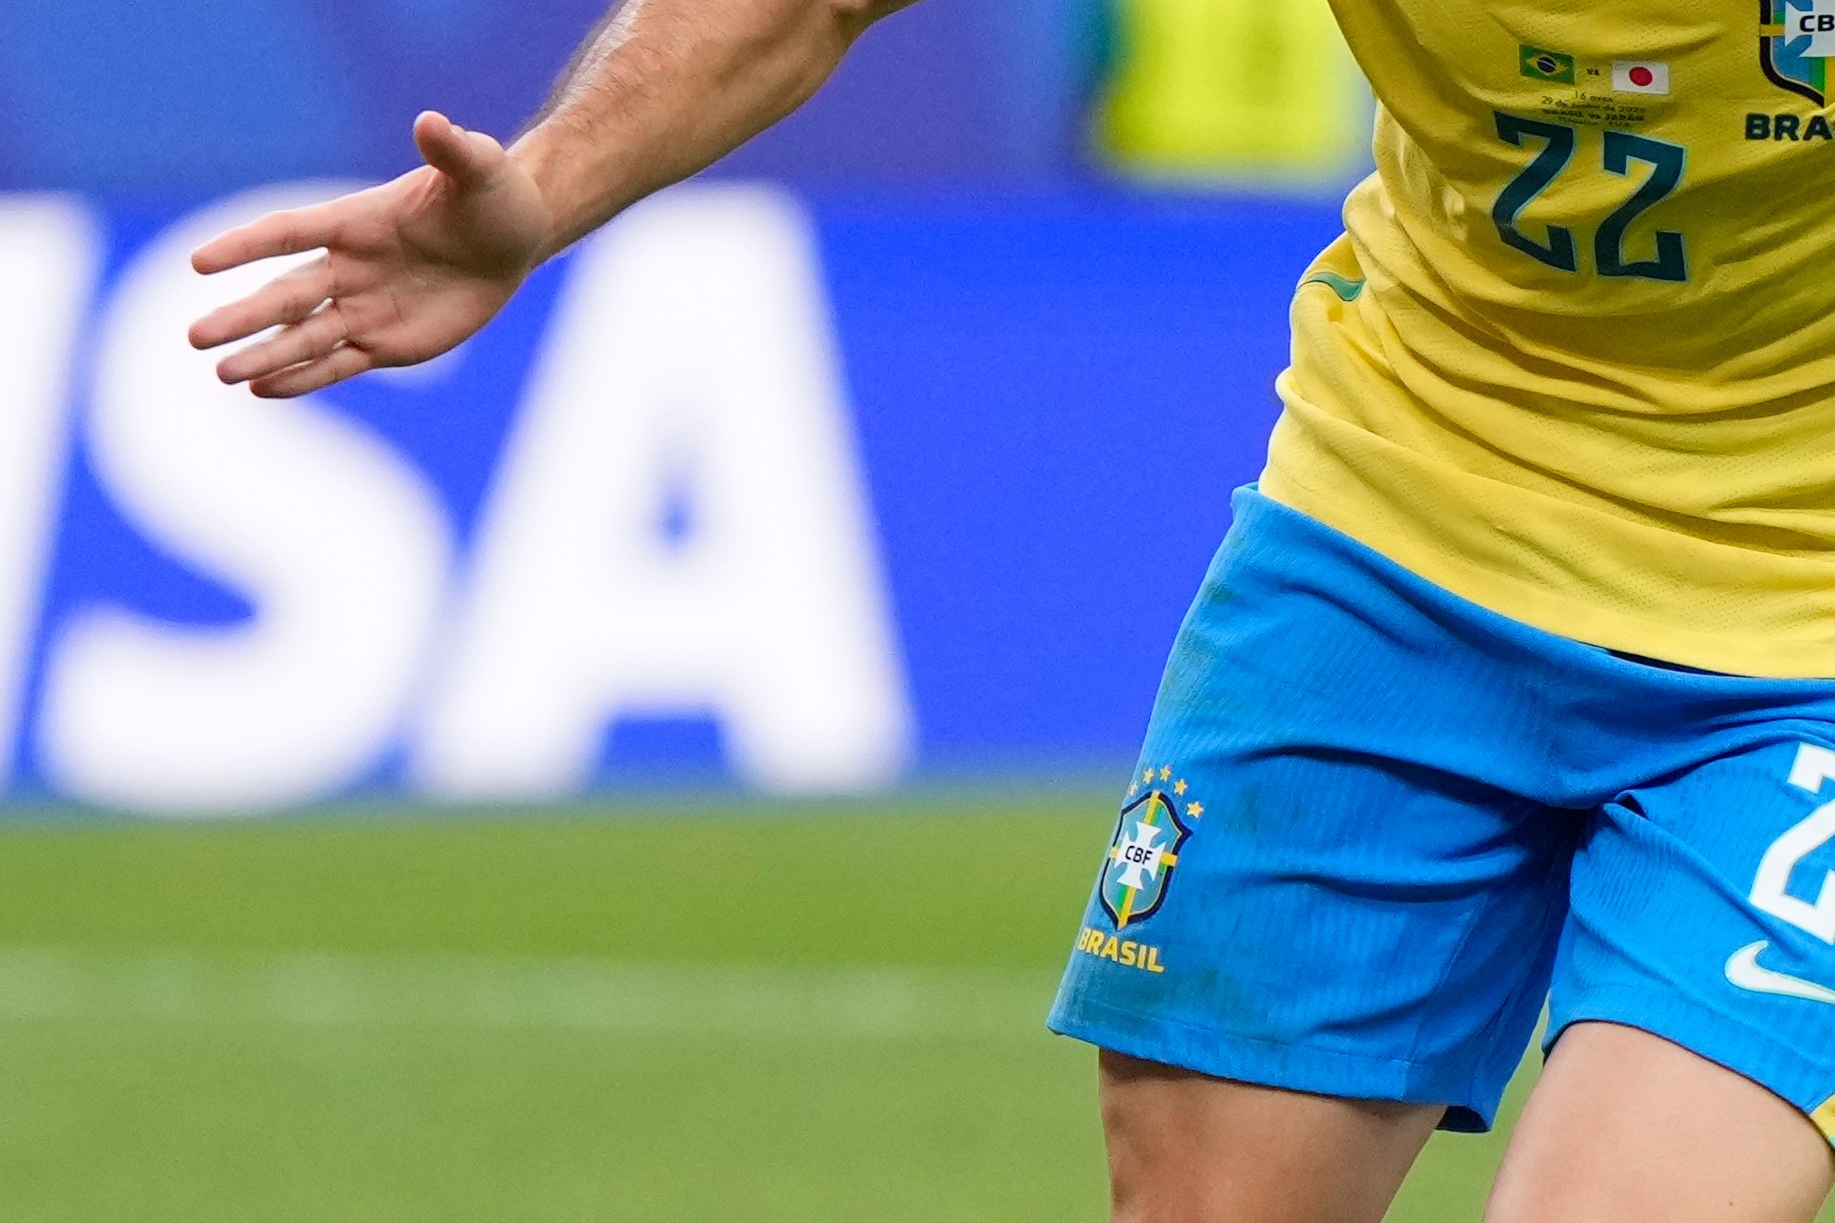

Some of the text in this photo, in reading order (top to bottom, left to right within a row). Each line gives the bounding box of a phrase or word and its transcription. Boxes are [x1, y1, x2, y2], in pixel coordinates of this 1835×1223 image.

[1491, 110, 1688, 282] 22
[1125, 845, 1154, 865] CBF
[1077, 927, 1166, 974] BRASIL
